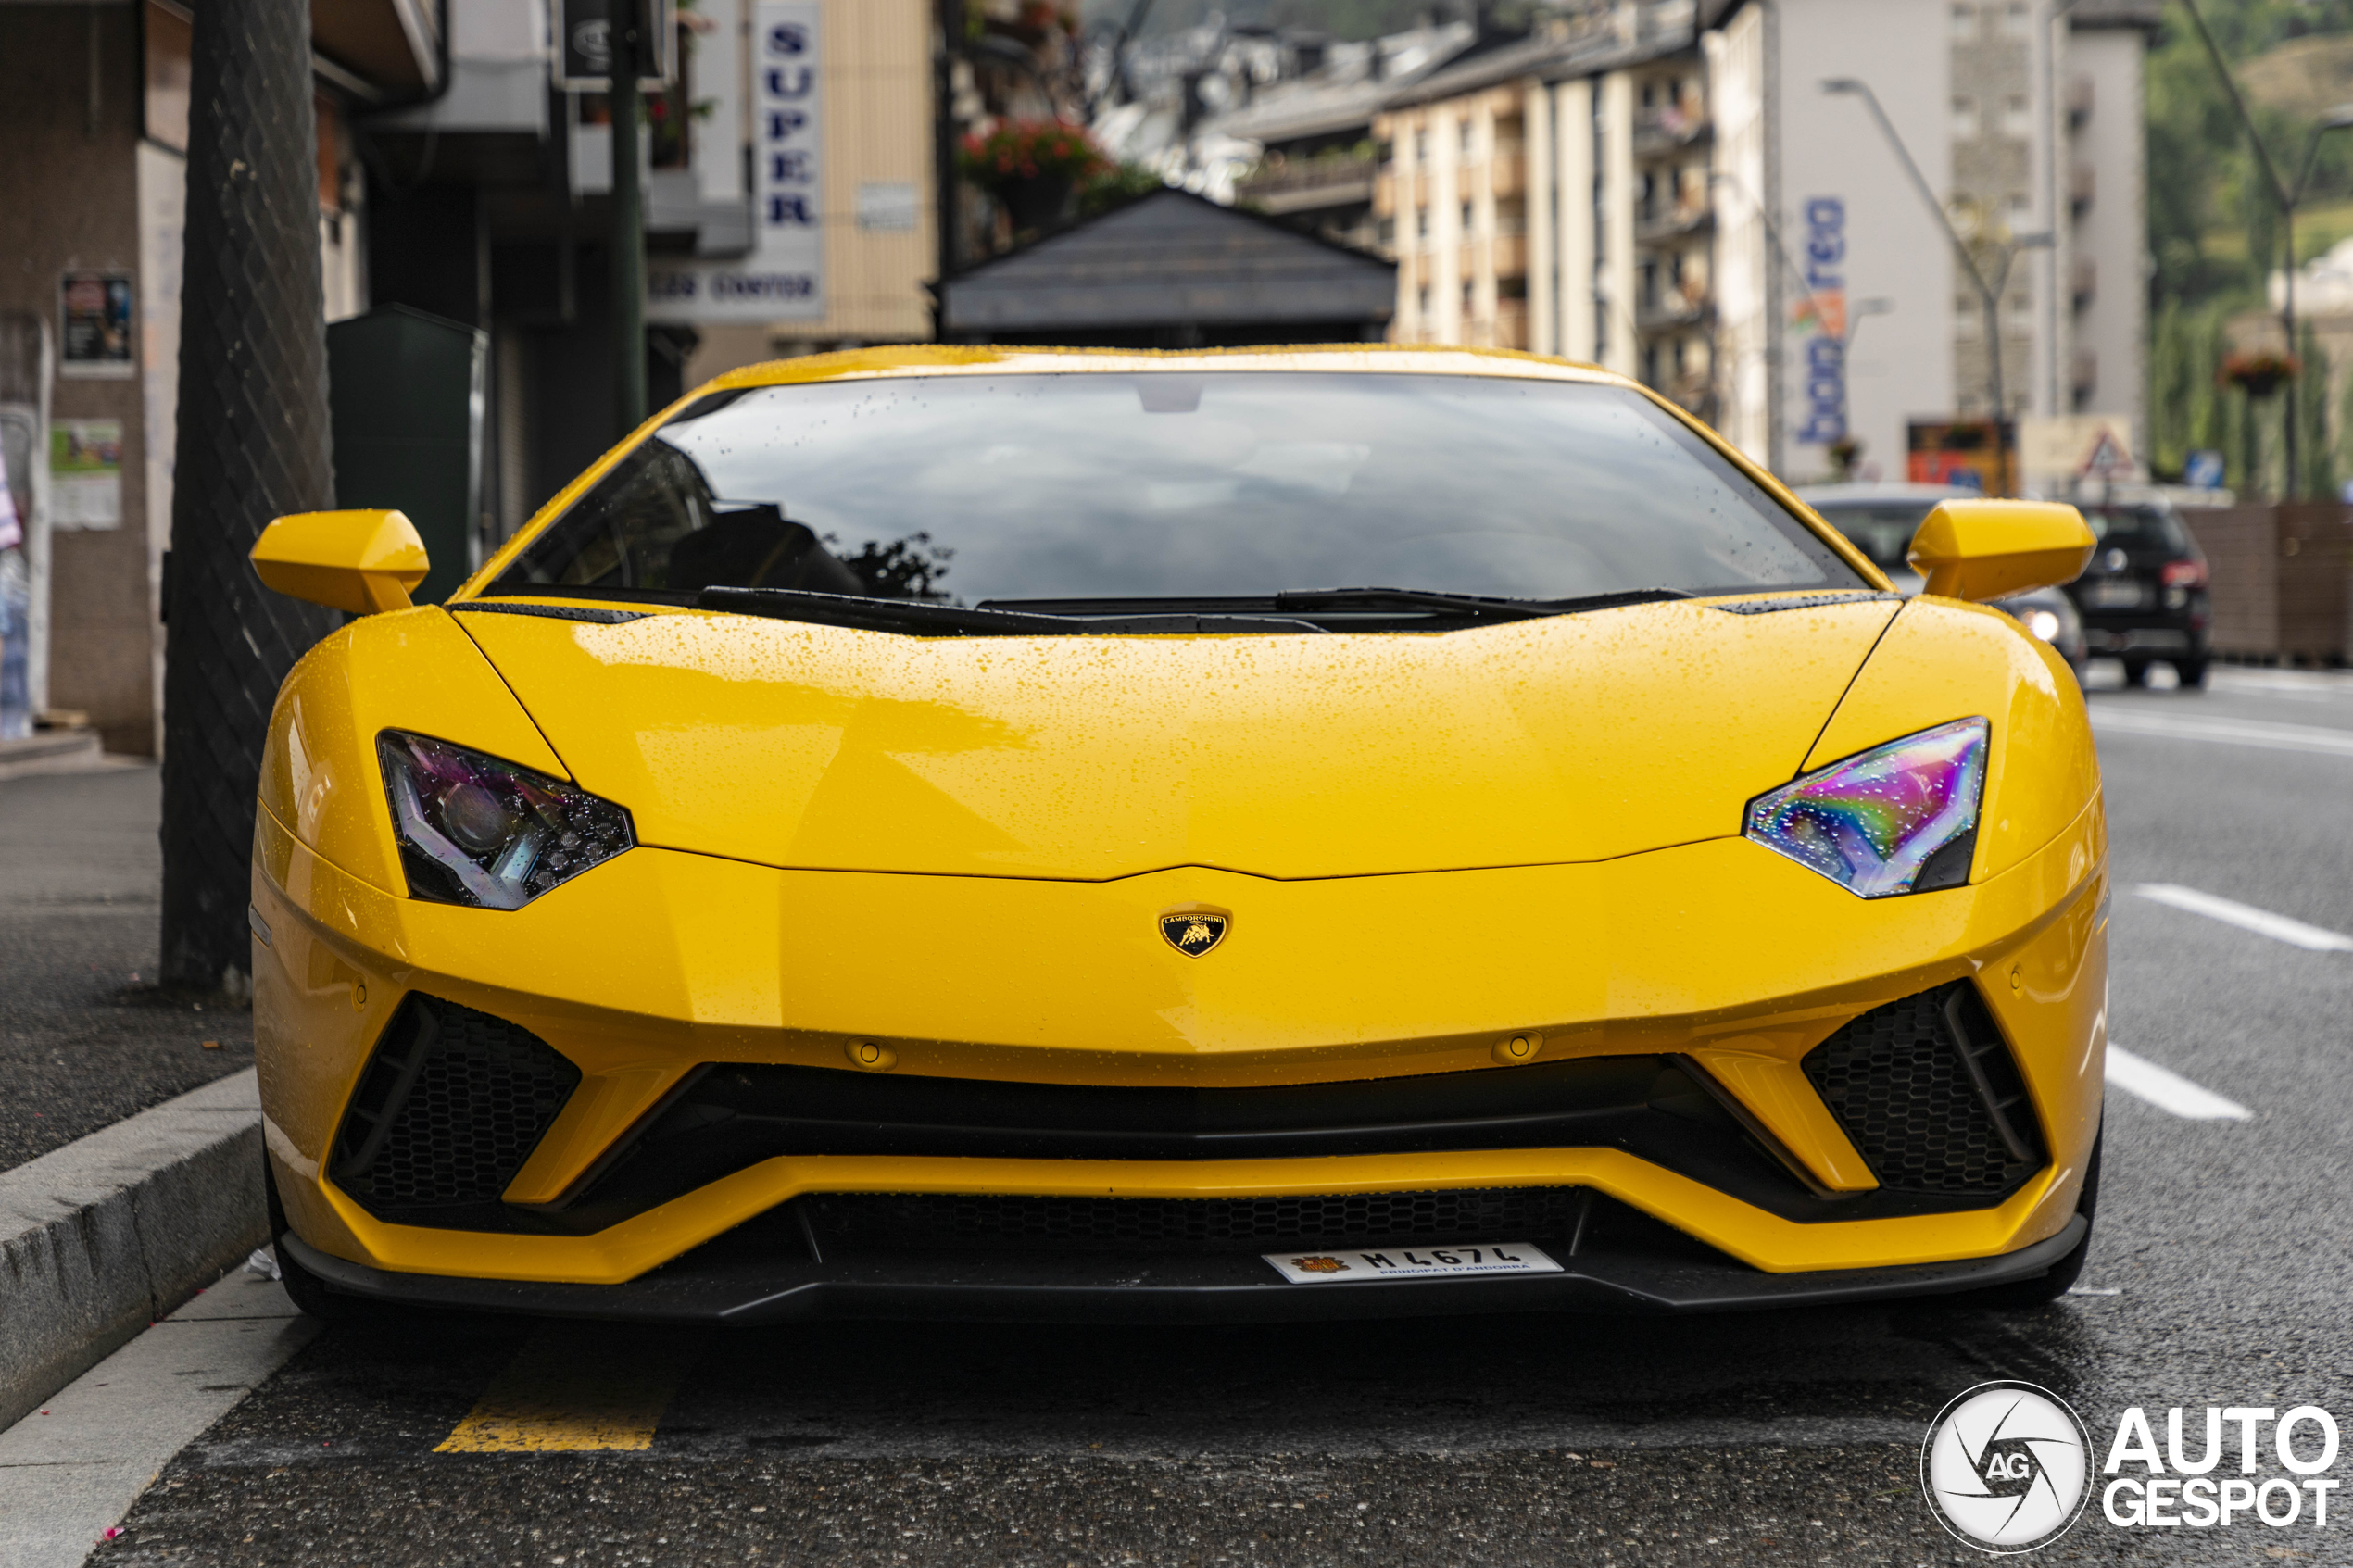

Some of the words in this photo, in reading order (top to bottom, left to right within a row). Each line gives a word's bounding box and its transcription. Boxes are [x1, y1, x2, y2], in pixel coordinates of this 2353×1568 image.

[767, 22, 815, 226] SUPER
[1164, 915, 1223, 924] LAMBORGHINI
[1360, 1253, 1397, 1268] M
[1403, 1248, 1521, 1266] 4674
[1379, 1267, 1449, 1275] PRINCIPAT
[1453, 1263, 1531, 1273] D'ANDORRA
